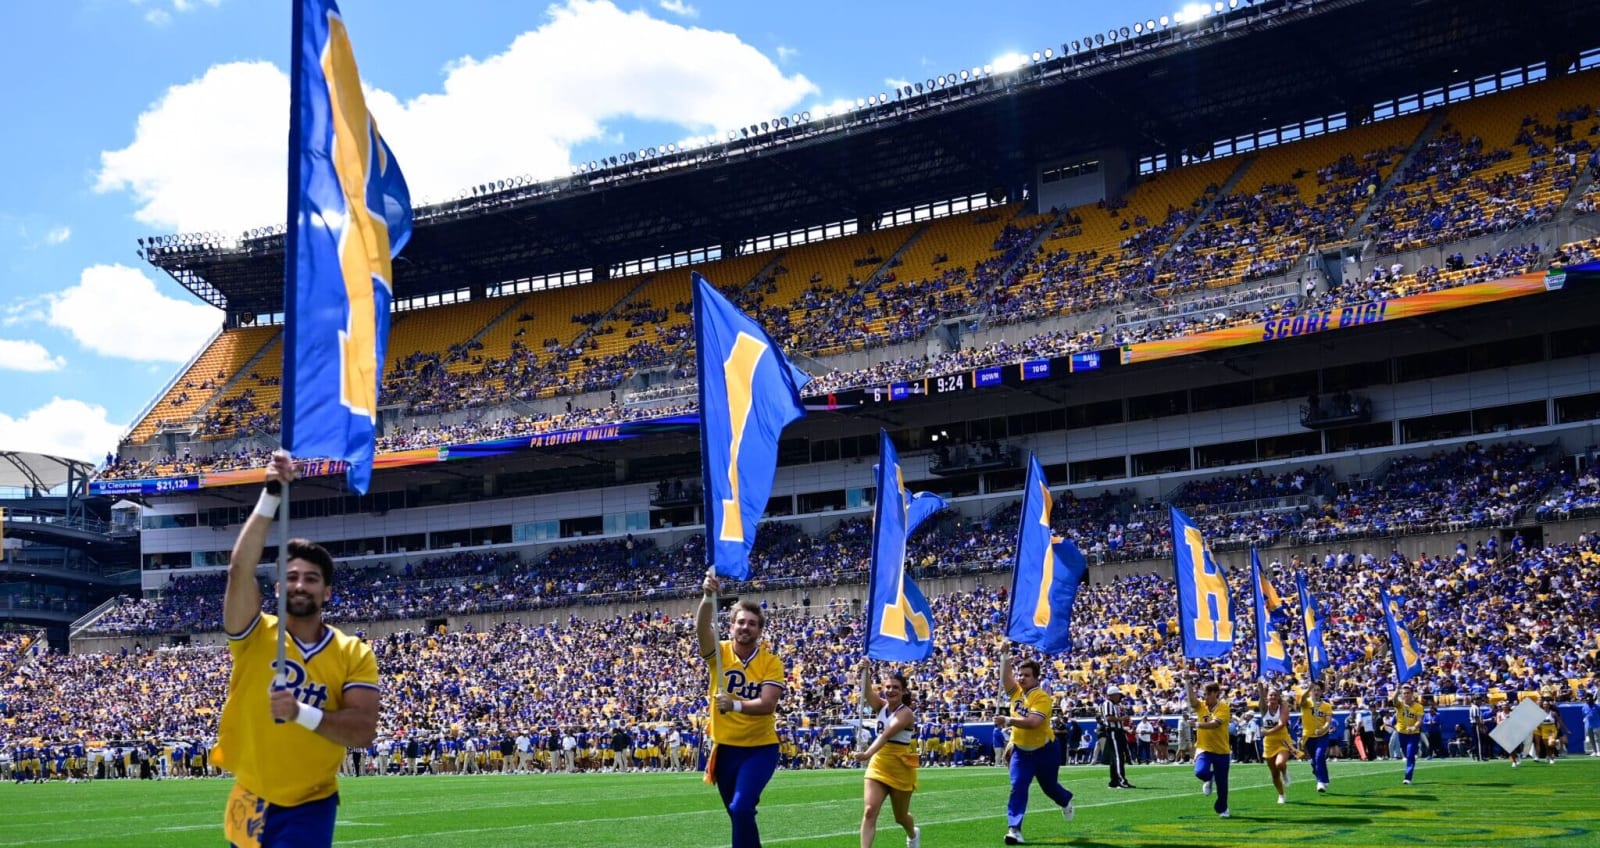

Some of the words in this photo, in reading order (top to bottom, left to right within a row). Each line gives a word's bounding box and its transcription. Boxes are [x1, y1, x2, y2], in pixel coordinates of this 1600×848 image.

[1262, 311, 1332, 341] SCORE
[1339, 298, 1387, 328] BIG!
[914, 383, 920, 394] 2
[937, 374, 963, 393] 9:24
[874, 389, 881, 402] 6
[530, 437, 543, 449] PA
[545, 431, 583, 446] LOTTERY
[585, 426, 620, 441] ONLINE
[156, 479, 188, 491] $21,120
[1184, 525, 1234, 642] H
[724, 669, 763, 701] Pitt
